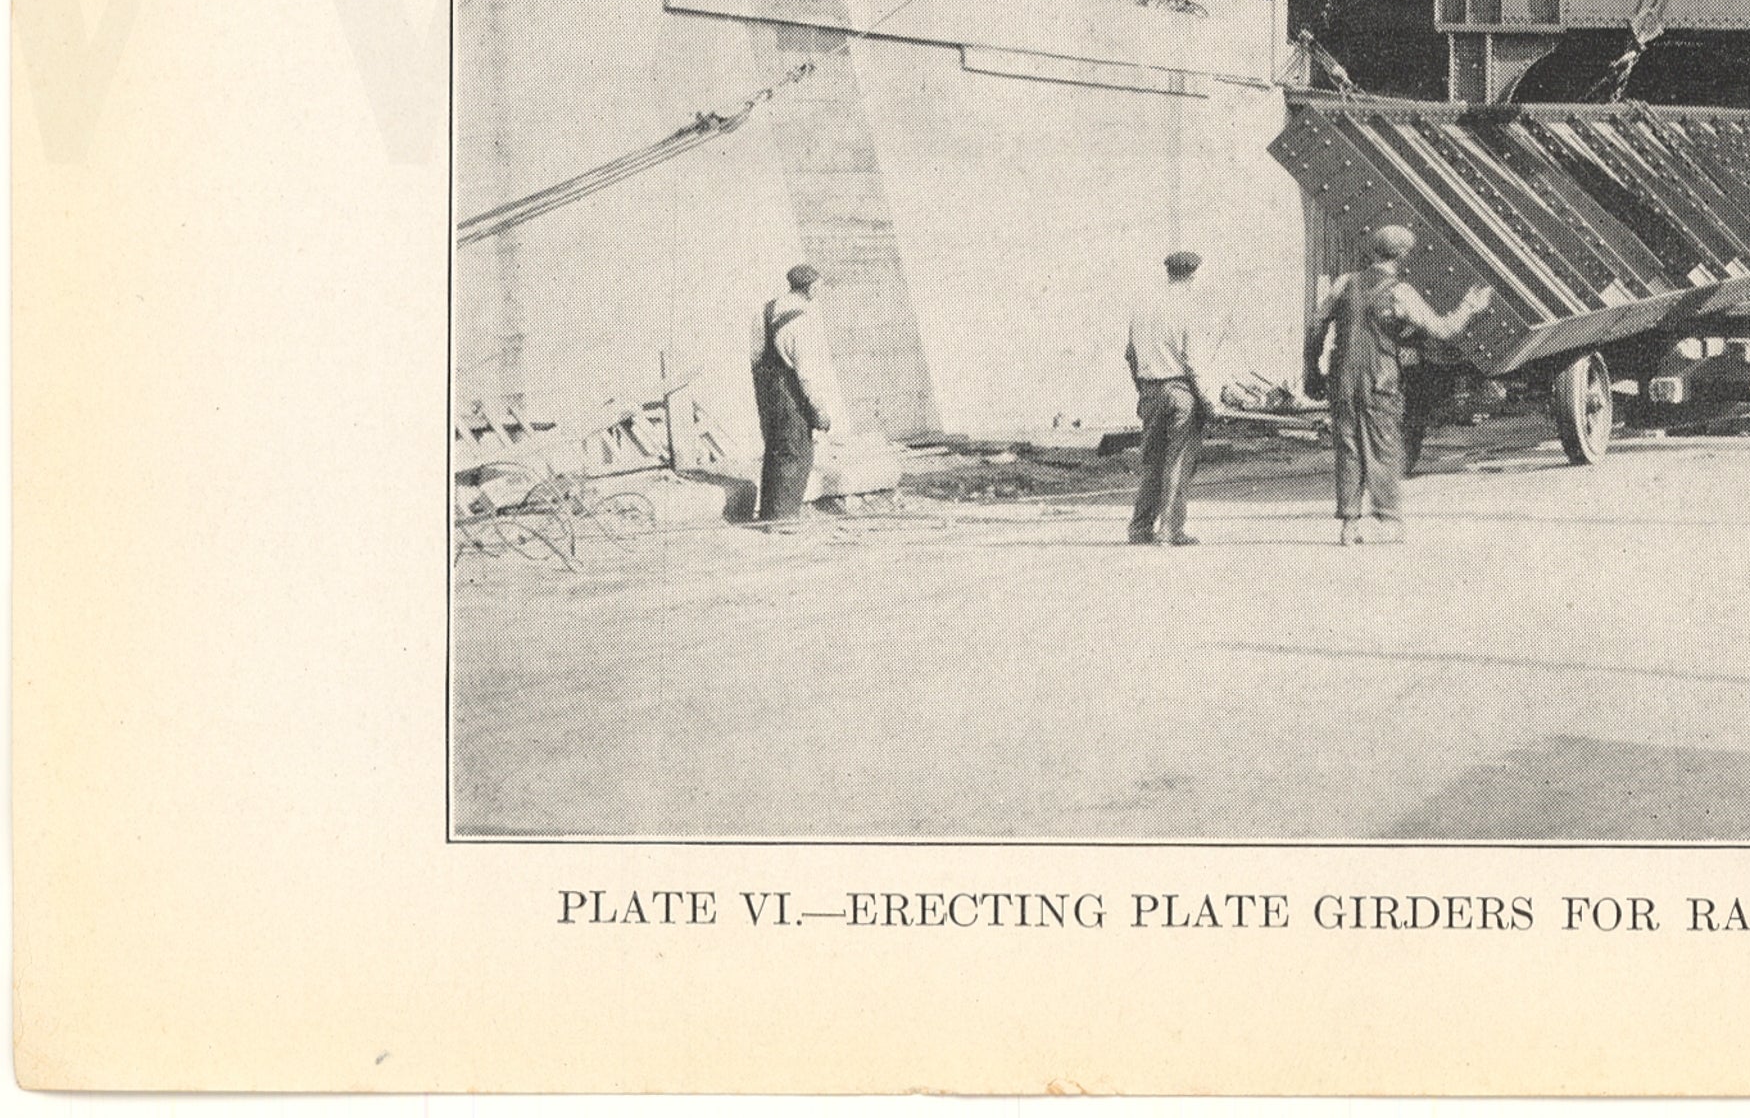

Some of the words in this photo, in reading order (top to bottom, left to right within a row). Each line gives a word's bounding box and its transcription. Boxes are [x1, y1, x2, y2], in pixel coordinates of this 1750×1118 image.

[560, 891, 717, 923] PLATE
[1132, 895, 1290, 927] PLATE
[1312, 896, 1536, 929] GIRDERS
[1564, 898, 1661, 930] FOR
